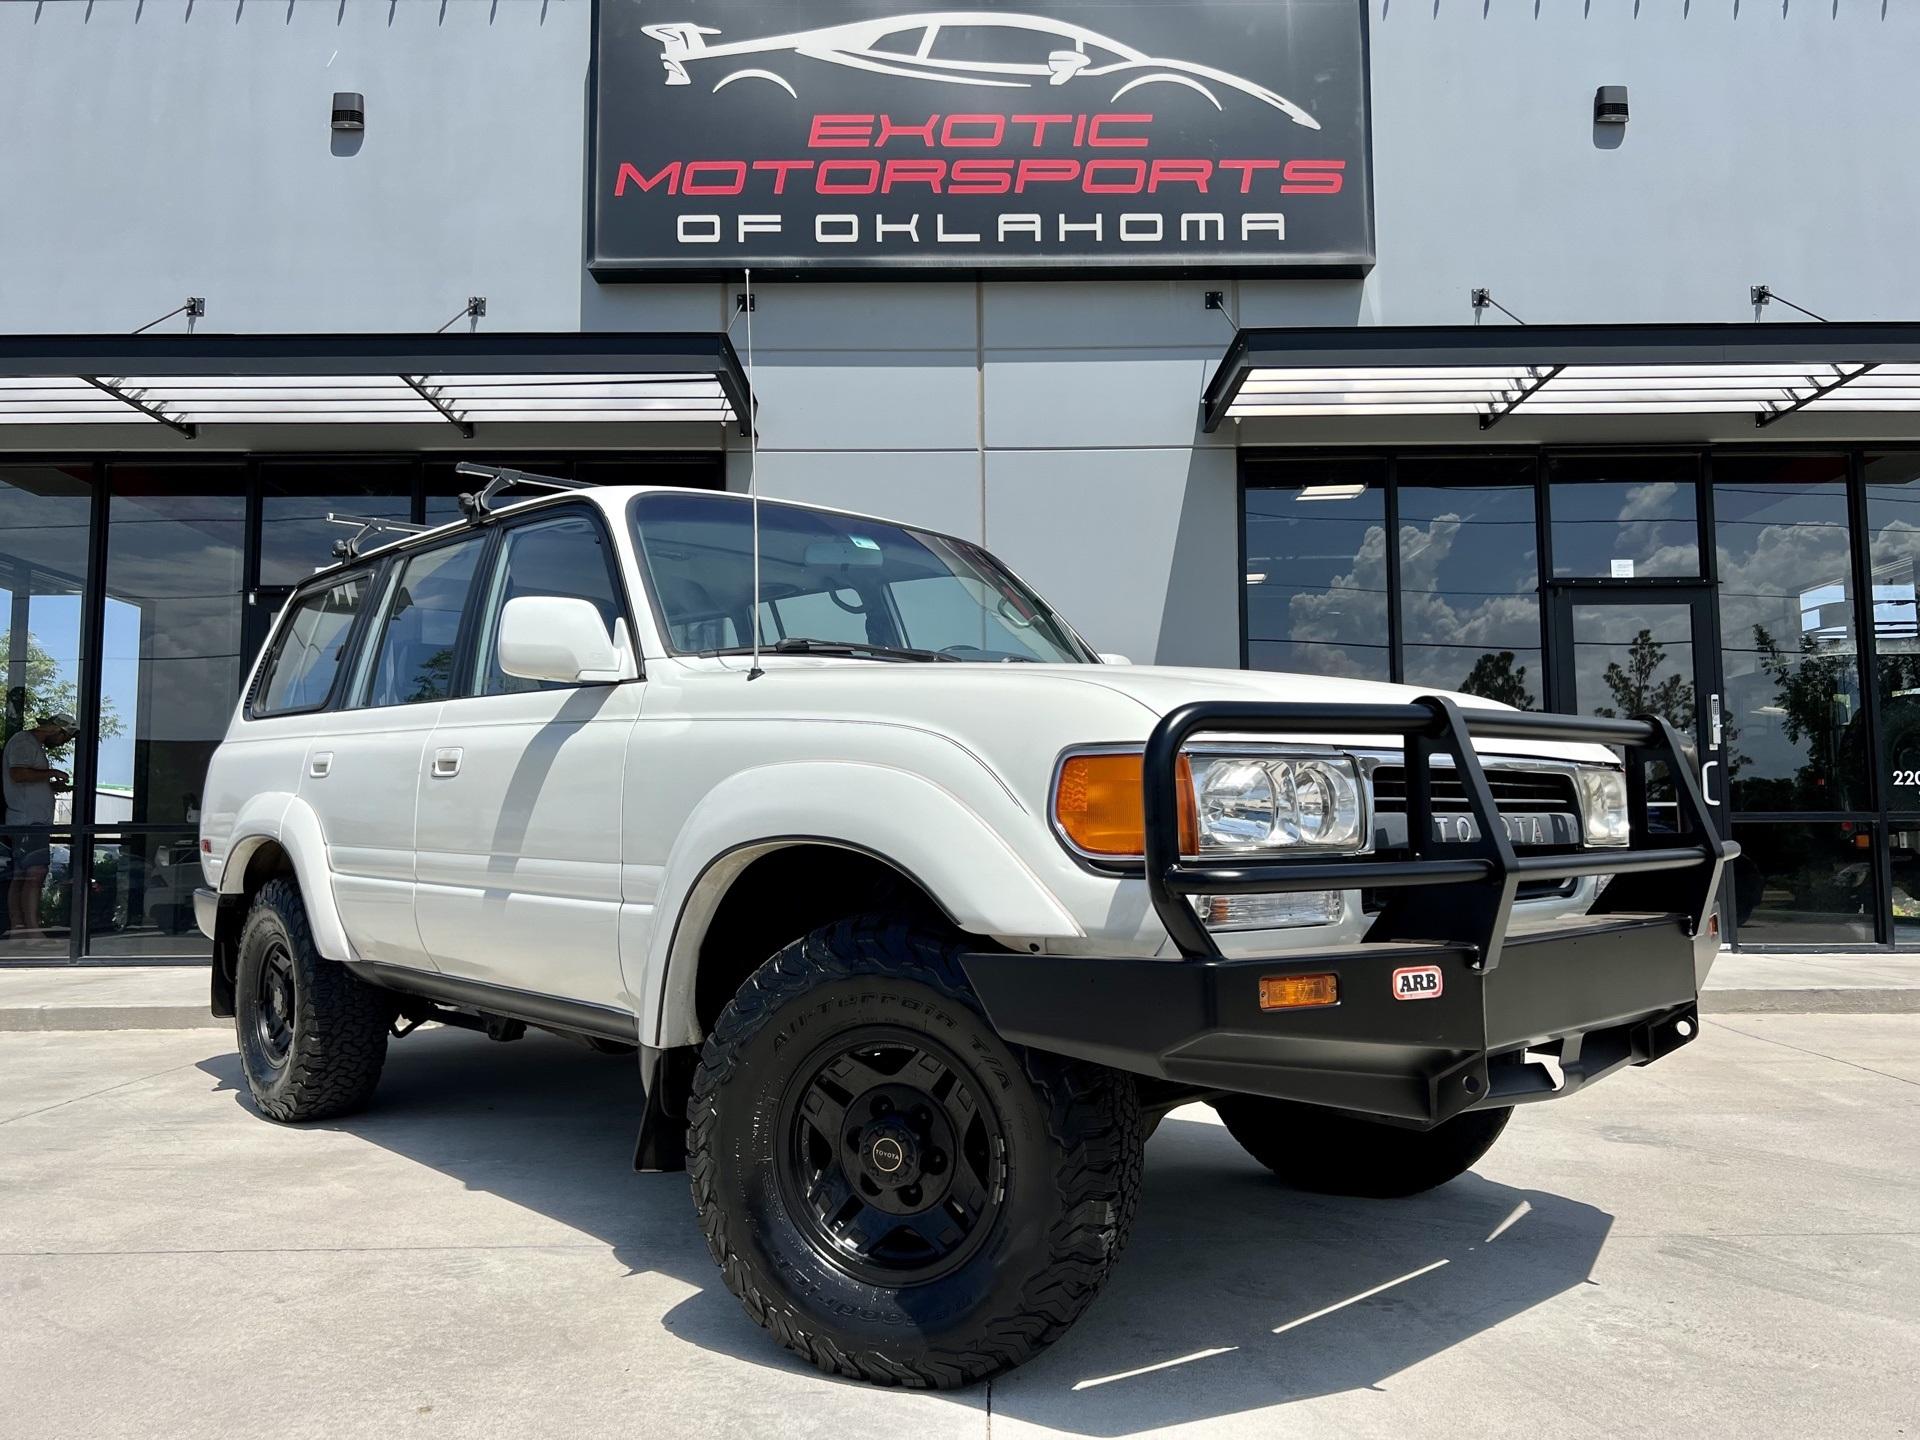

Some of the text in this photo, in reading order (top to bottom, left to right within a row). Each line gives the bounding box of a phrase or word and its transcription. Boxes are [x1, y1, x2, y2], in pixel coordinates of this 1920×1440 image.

[807, 114, 1153, 149] EXOTIC
[614, 158, 1346, 197] MOTORSPORTS
[677, 212, 1286, 243] OF OKLAHOMA
[1434, 816, 1545, 844] TOOTA
[1400, 973, 1438, 993] ARB
[875, 1149, 900, 1161] TOYOTA
